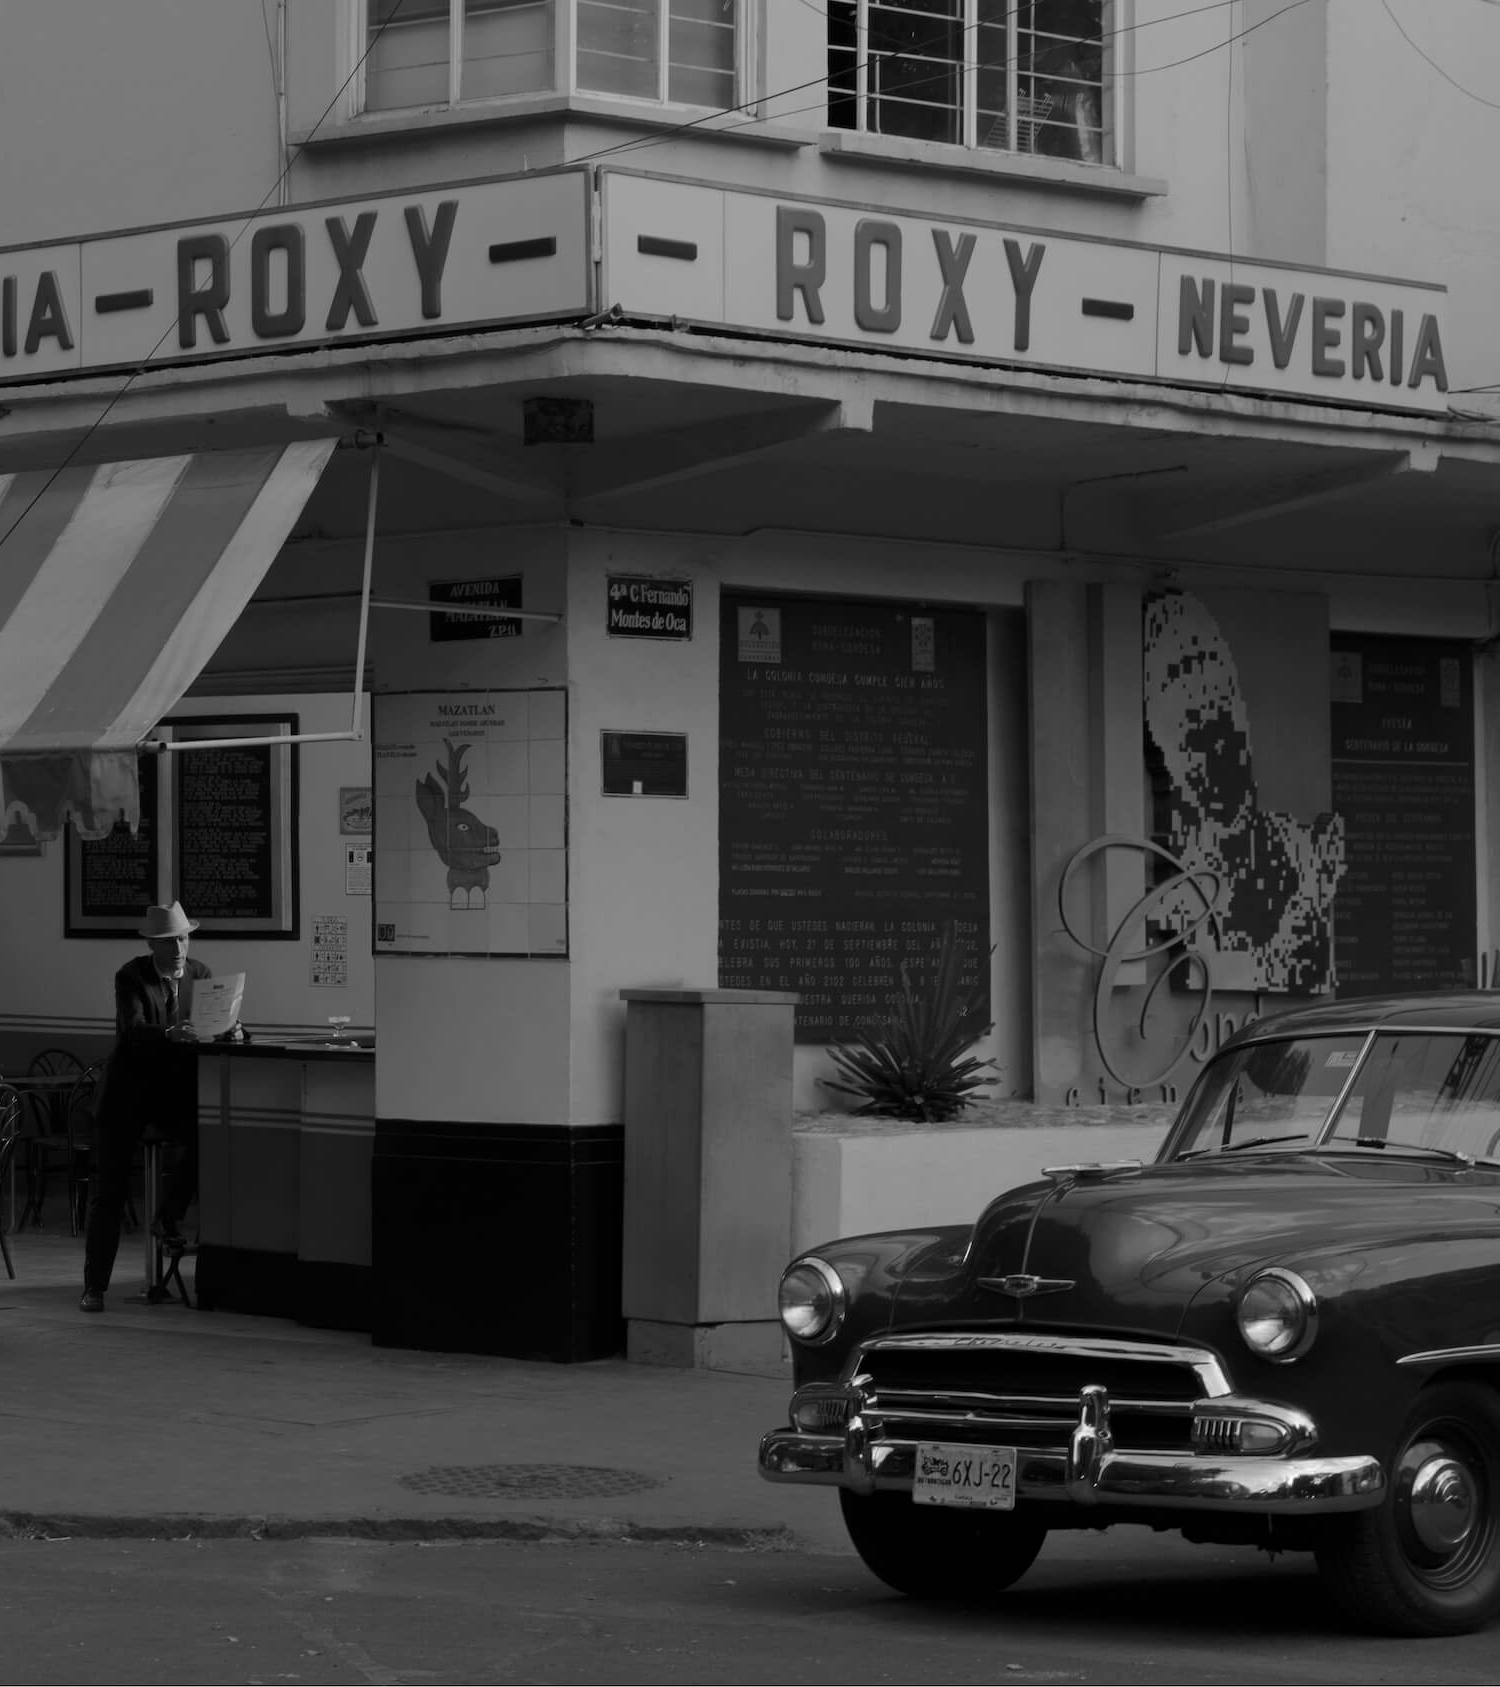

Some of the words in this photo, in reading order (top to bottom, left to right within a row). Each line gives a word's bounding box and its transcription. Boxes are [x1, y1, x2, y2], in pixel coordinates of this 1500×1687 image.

[177, 199, 461, 350] ROXY
[775, 204, 1048, 352] ROXY
[1178, 273, 1450, 393] NEVERIA
[450, 582, 500, 598] AVENIDA
[630, 584, 639, 602] C
[640, 584, 688, 607] Fernando
[611, 608, 651, 629] Montes
[652, 611, 665, 630] de
[666, 613, 686, 631] Oca
[747, 668, 758, 681] LA
[438, 704, 495, 716] MAZATLAN
[719, 919, 741, 931] NTES
[952, 1460, 1011, 1489] 6XJ-22
